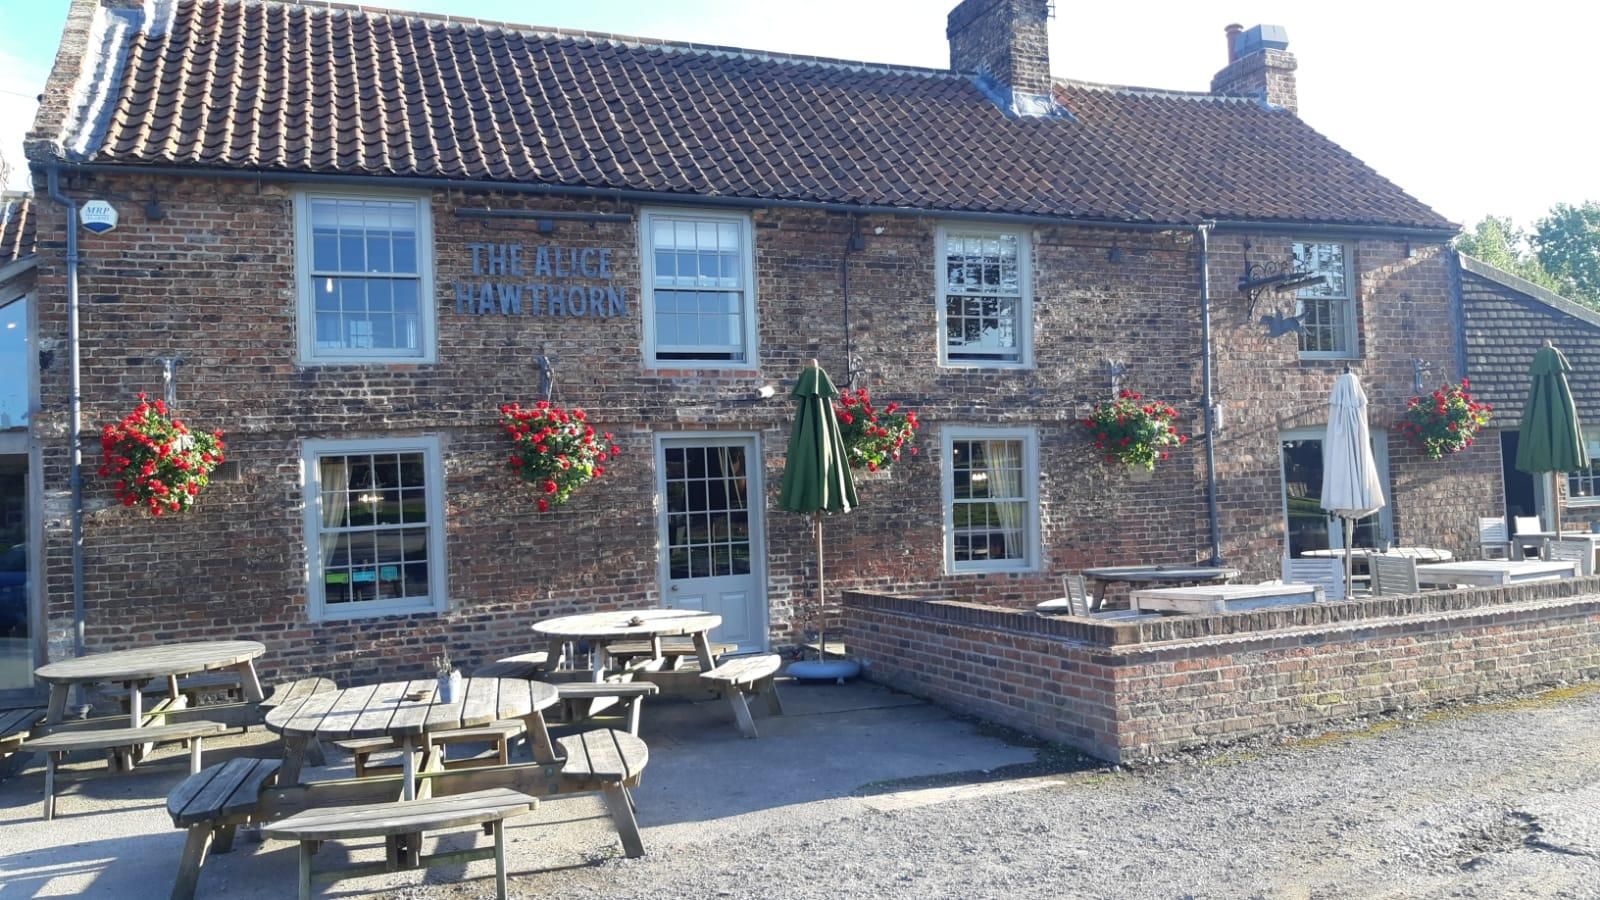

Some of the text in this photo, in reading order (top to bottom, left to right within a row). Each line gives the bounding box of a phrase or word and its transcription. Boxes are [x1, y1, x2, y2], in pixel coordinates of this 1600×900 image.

[466, 242, 614, 279] THE ALICE
[453, 281, 629, 317] HAWTHORN
